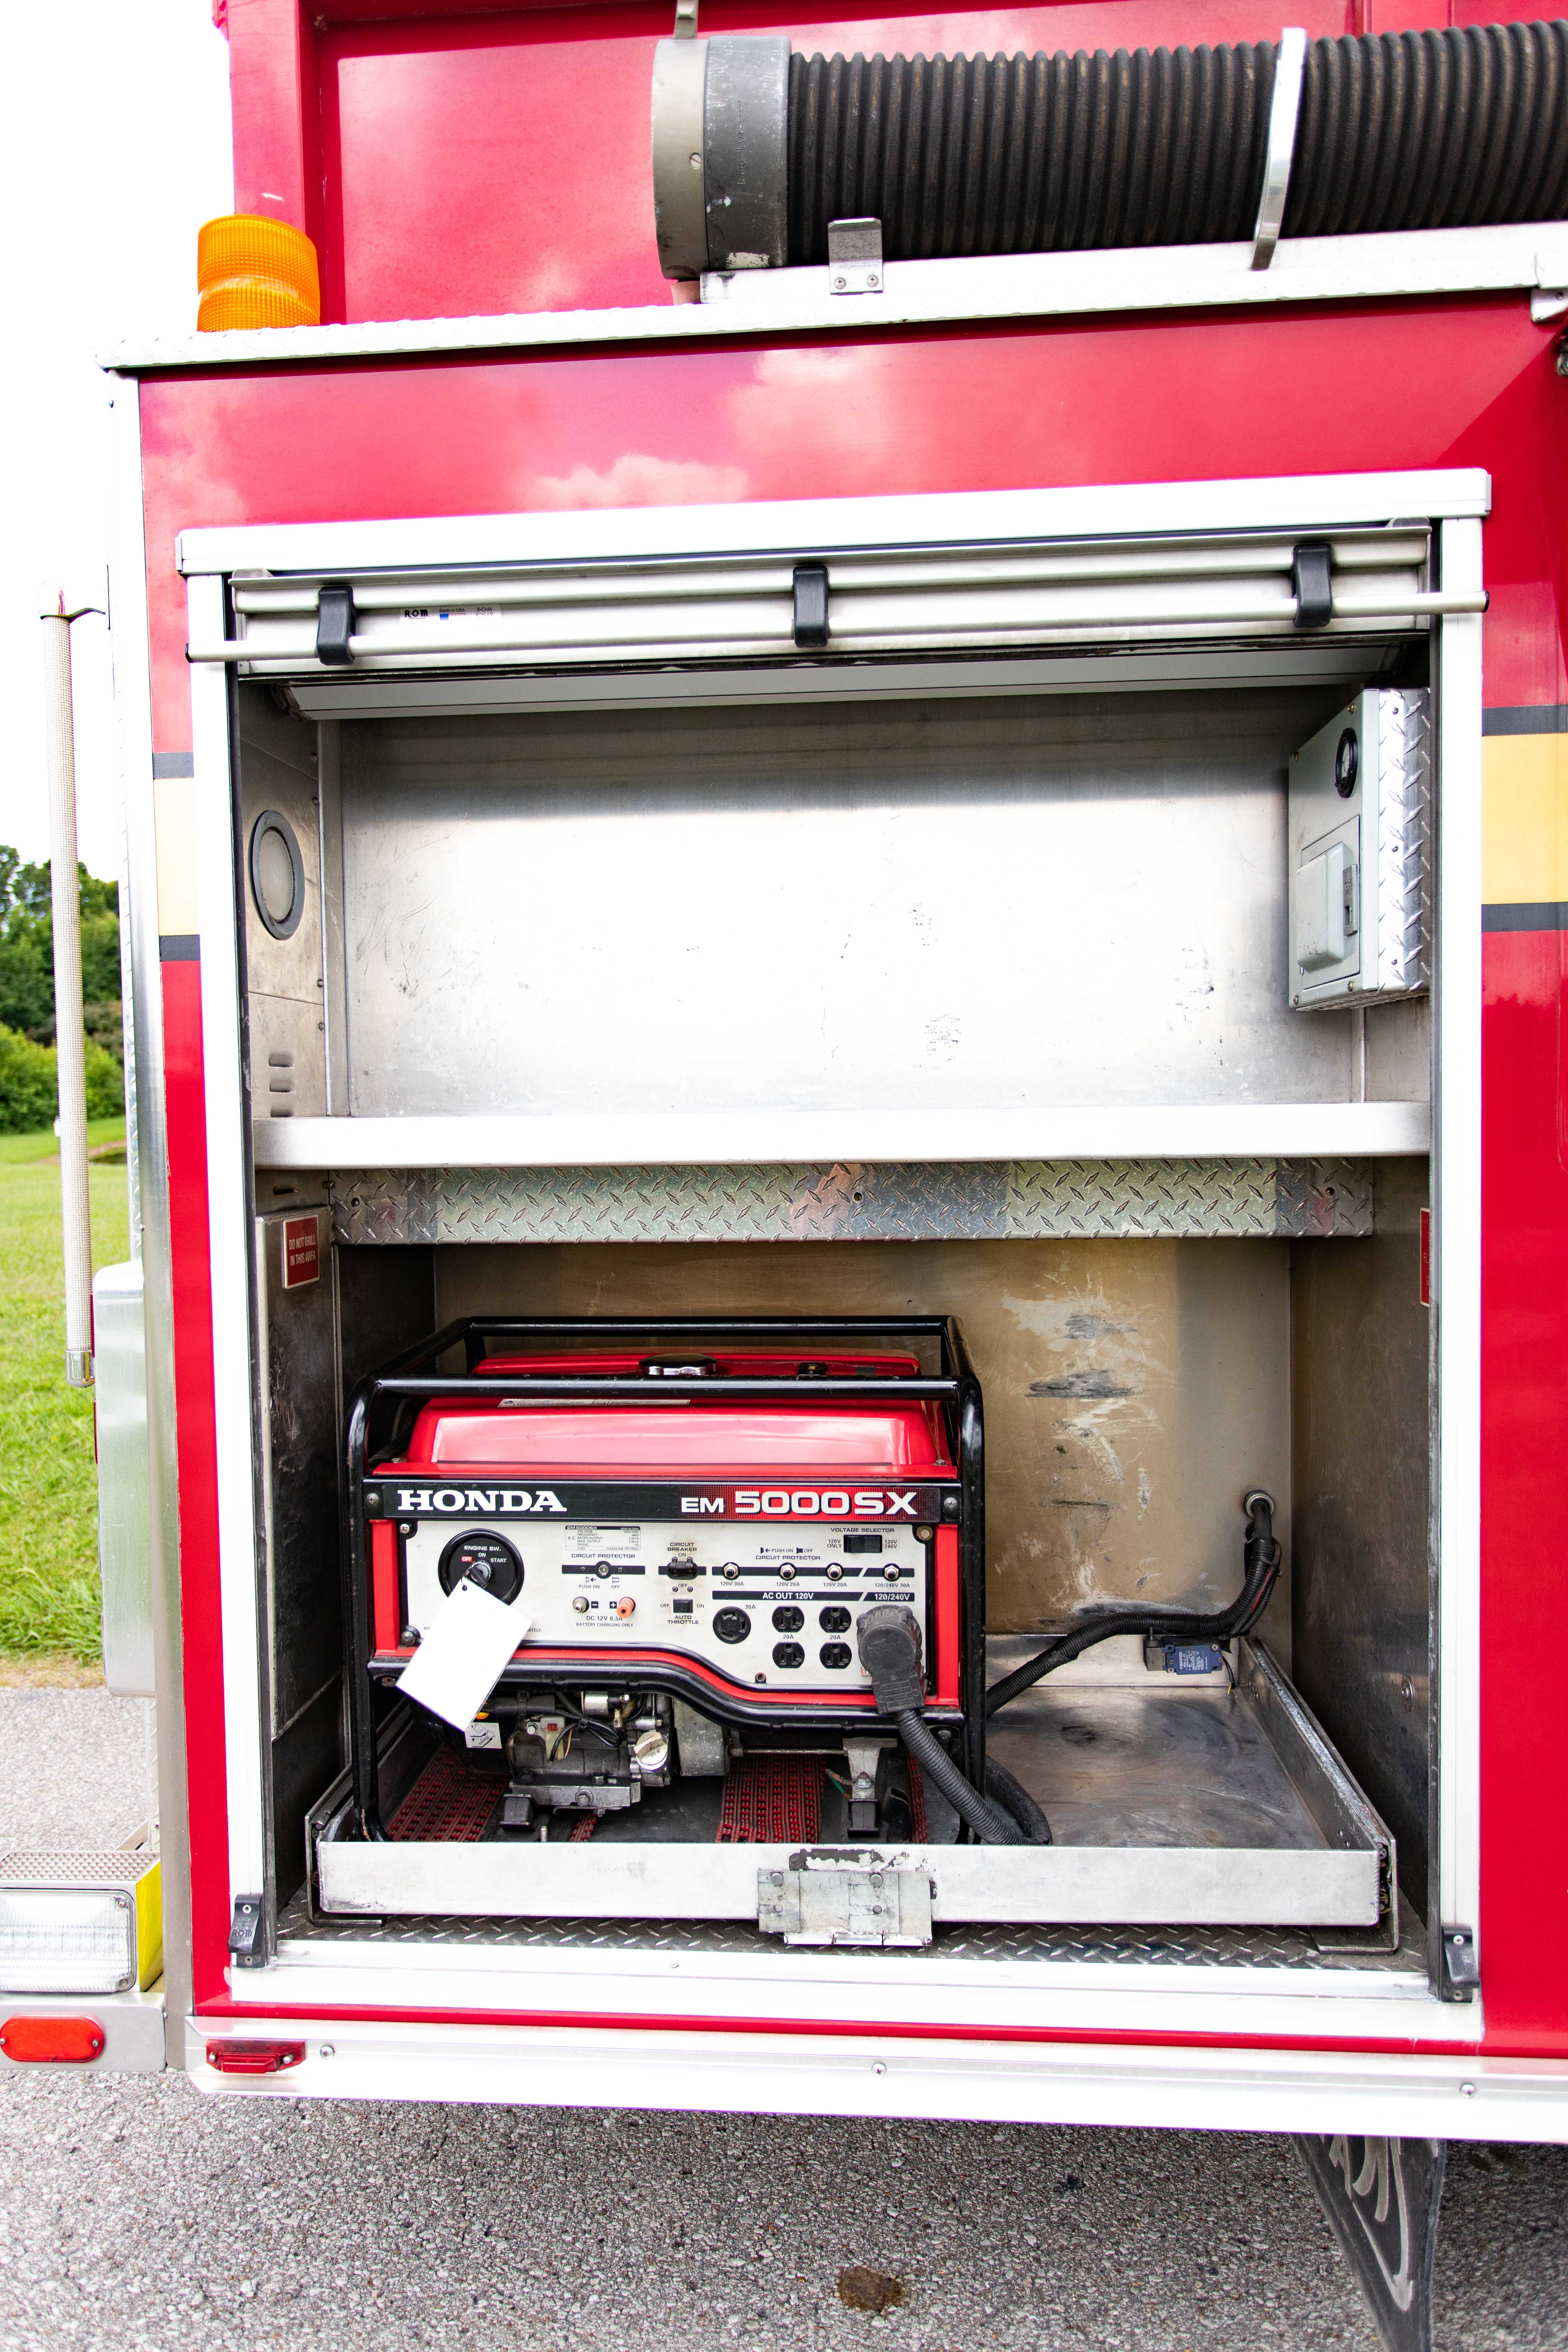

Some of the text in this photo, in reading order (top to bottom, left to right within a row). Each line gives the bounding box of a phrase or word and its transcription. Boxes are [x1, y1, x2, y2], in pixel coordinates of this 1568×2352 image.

[289, 1235, 316, 1250] DO NOT DRILL
[290, 1255, 295, 1266] IN
[295, 1253, 305, 1265] THIS
[397, 1490, 567, 1511] HONDA
[681, 1491, 918, 1515] EM 5000SX
